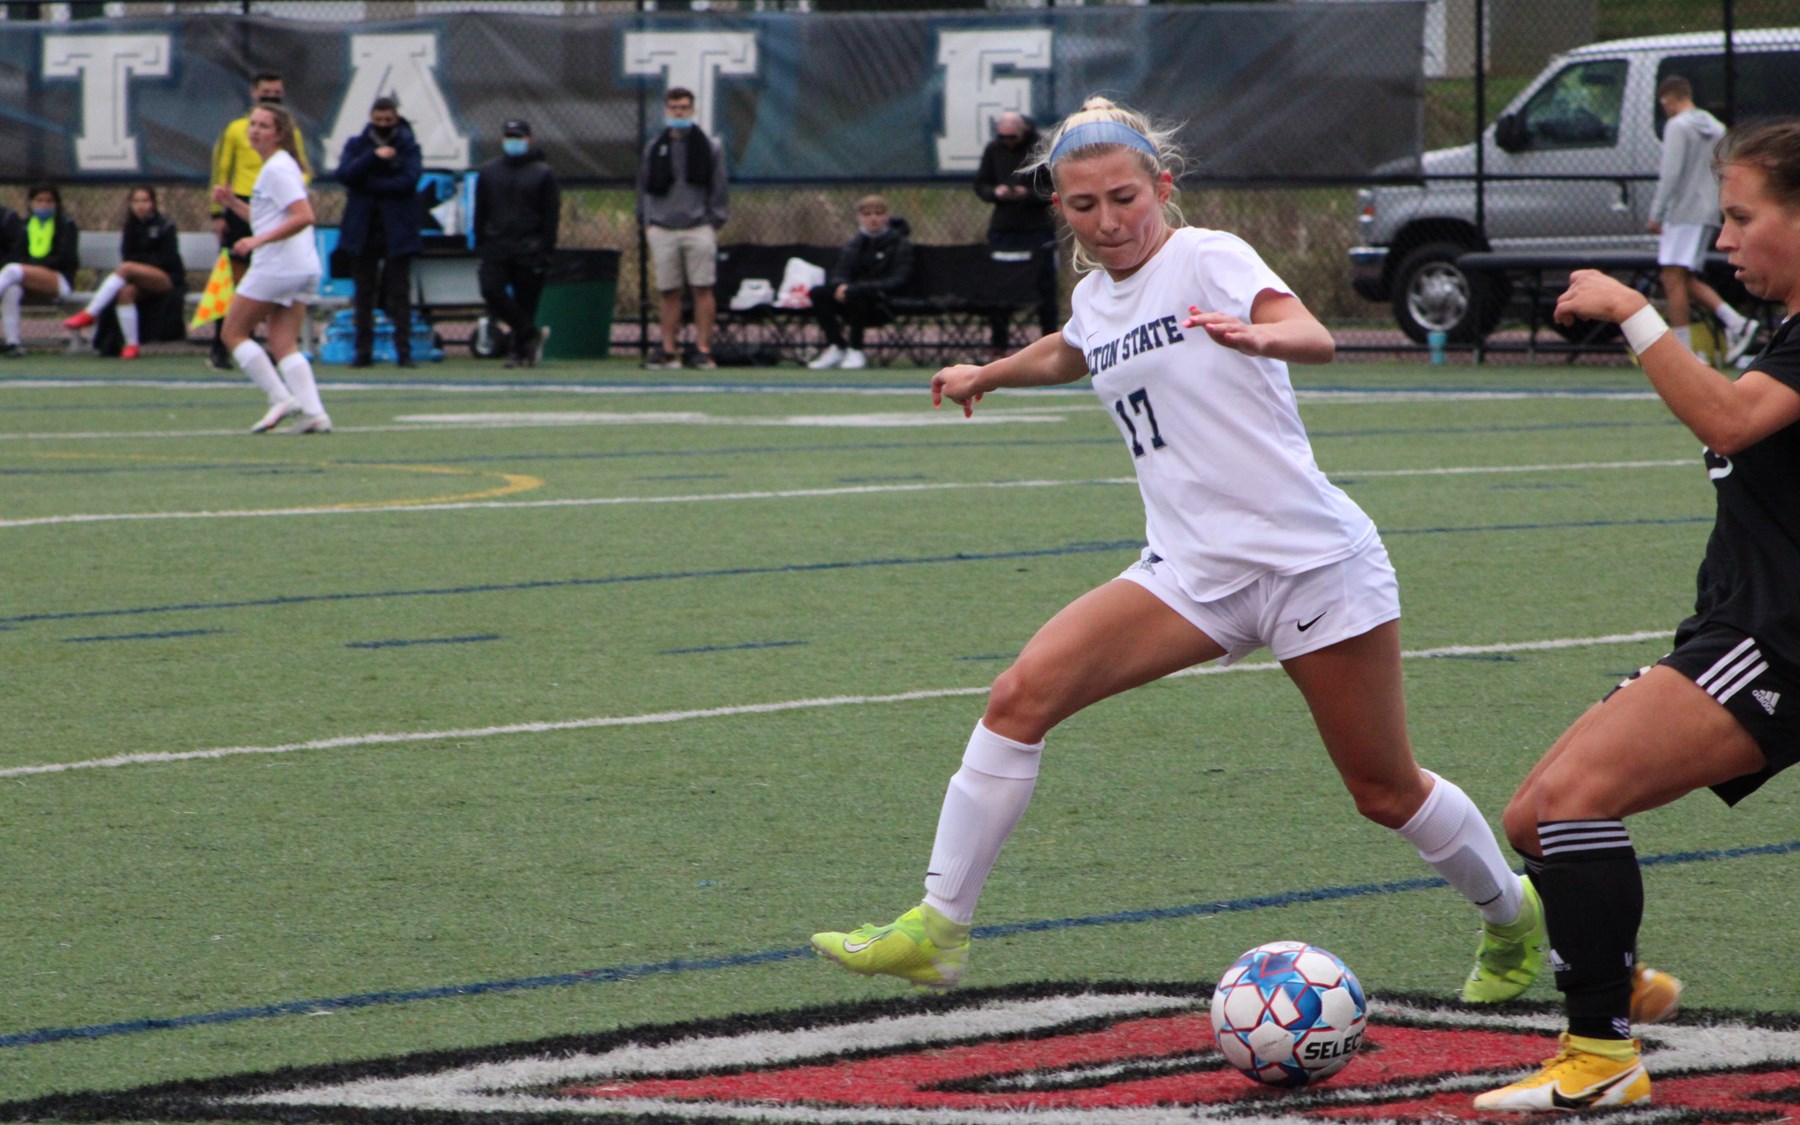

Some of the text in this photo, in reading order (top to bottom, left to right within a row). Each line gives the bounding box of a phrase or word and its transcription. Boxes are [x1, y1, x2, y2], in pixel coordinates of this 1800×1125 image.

[1122, 315, 1185, 361] STATE
[1115, 387, 1167, 458] 17
[1752, 689, 1776, 716] adidas
[1304, 1030, 1364, 1060] SELEC
